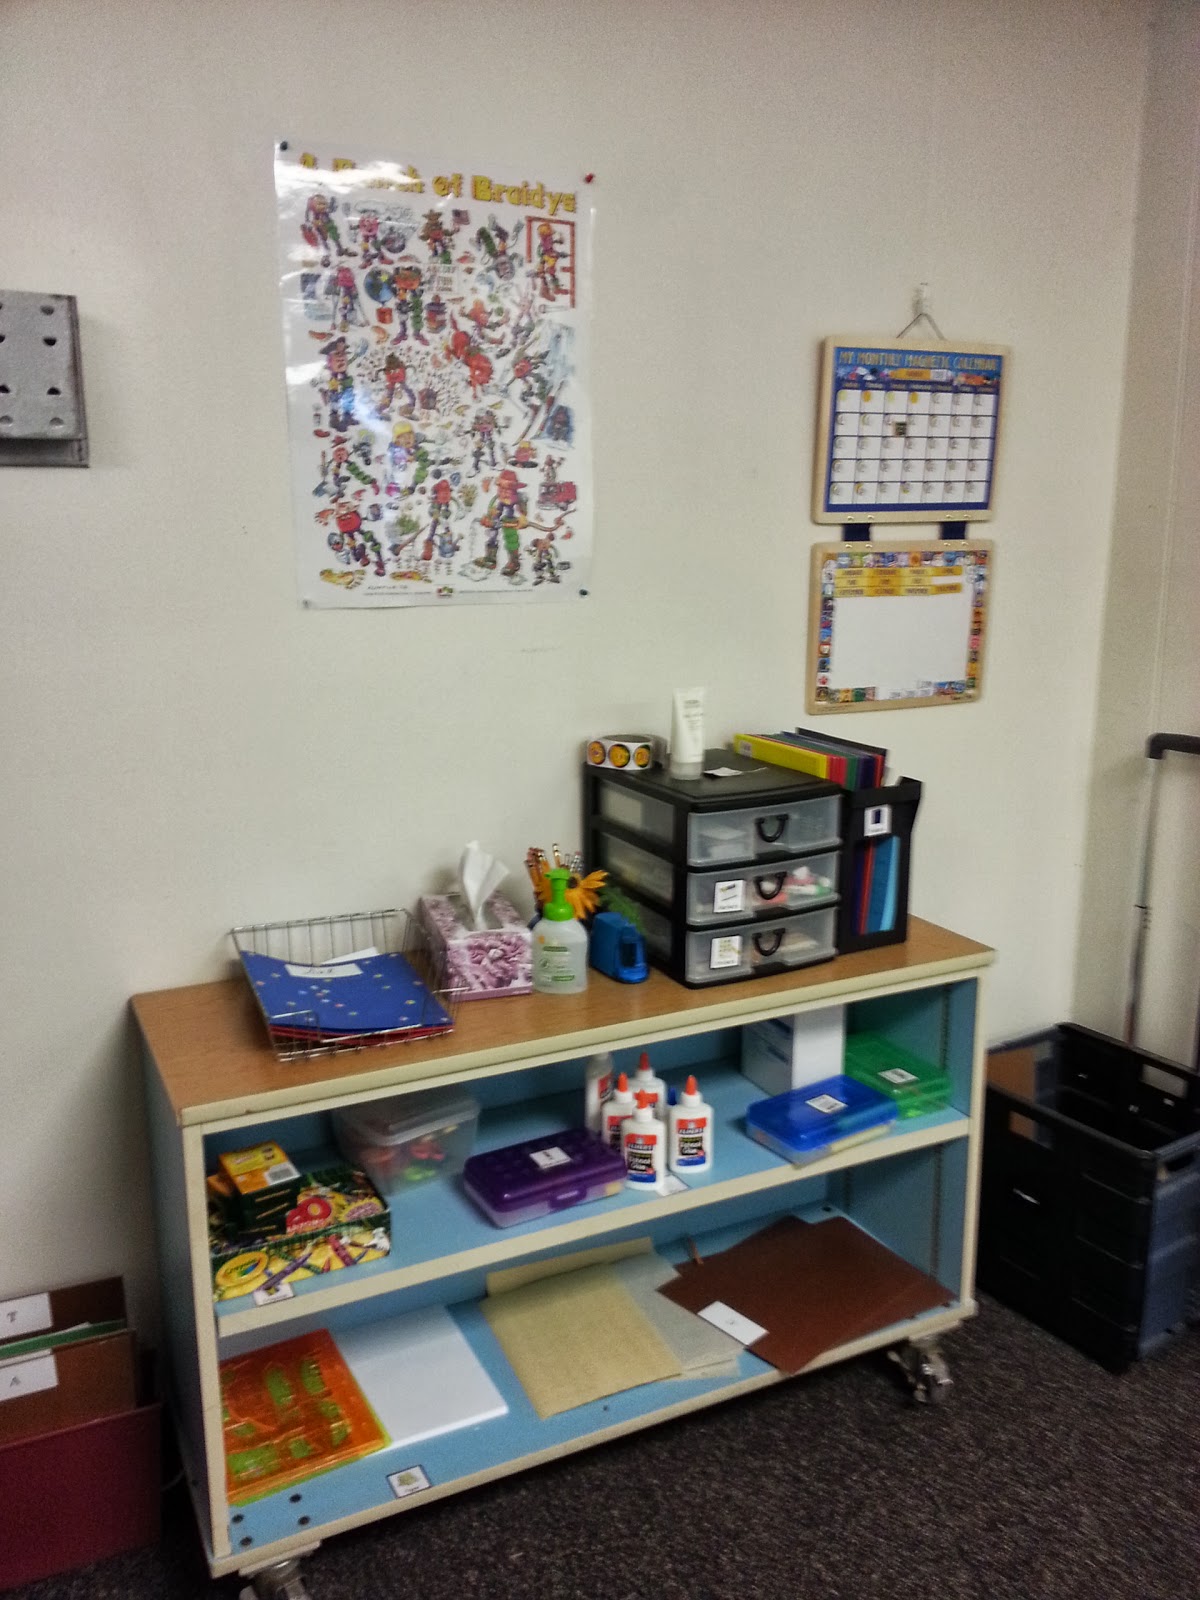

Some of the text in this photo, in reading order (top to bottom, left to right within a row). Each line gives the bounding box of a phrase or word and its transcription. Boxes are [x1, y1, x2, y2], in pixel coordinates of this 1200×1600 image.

[432, 173, 463, 198] of
[472, 175, 577, 214] Braidys
[10, 1376, 21, 1388] A
